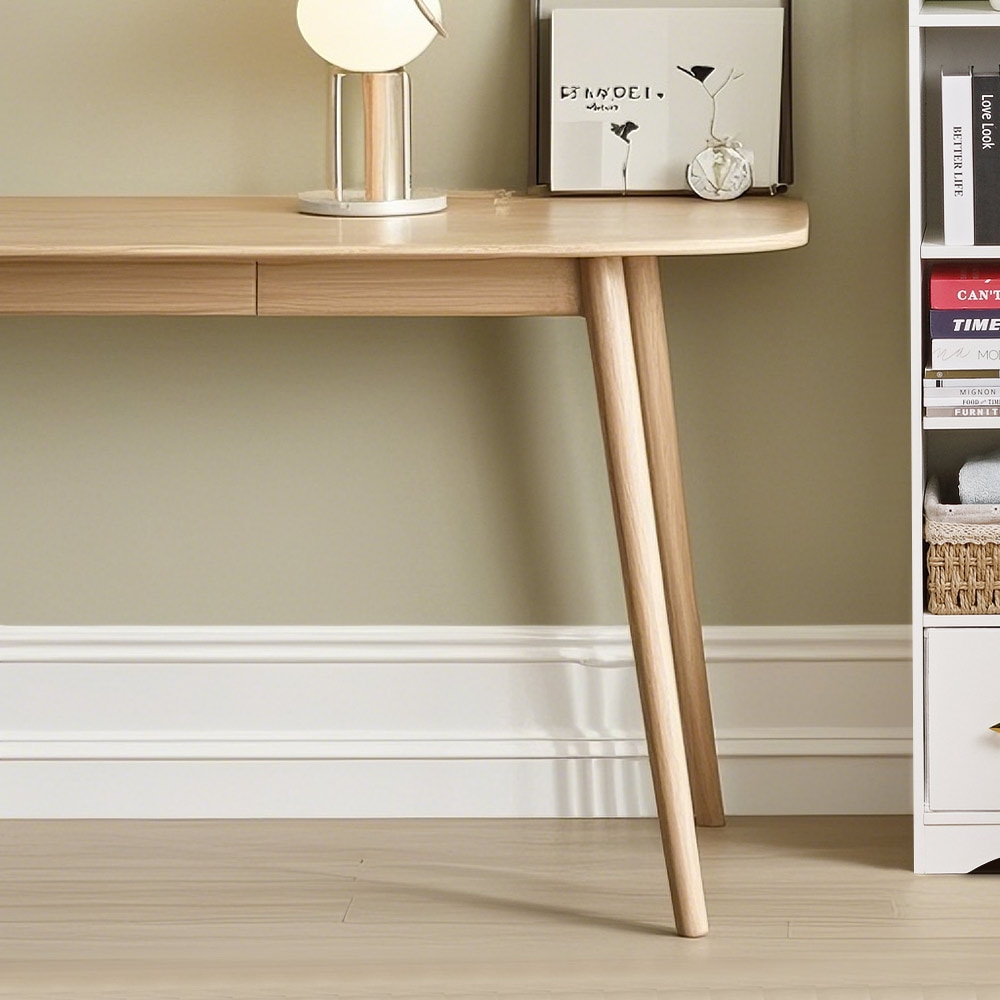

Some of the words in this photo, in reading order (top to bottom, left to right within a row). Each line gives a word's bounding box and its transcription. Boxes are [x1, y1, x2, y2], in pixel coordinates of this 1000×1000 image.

[981, 94, 994, 120] Love
[952, 126, 963, 169] BETTER
[981, 123, 995, 150] Look
[954, 172, 964, 197] LIFE
